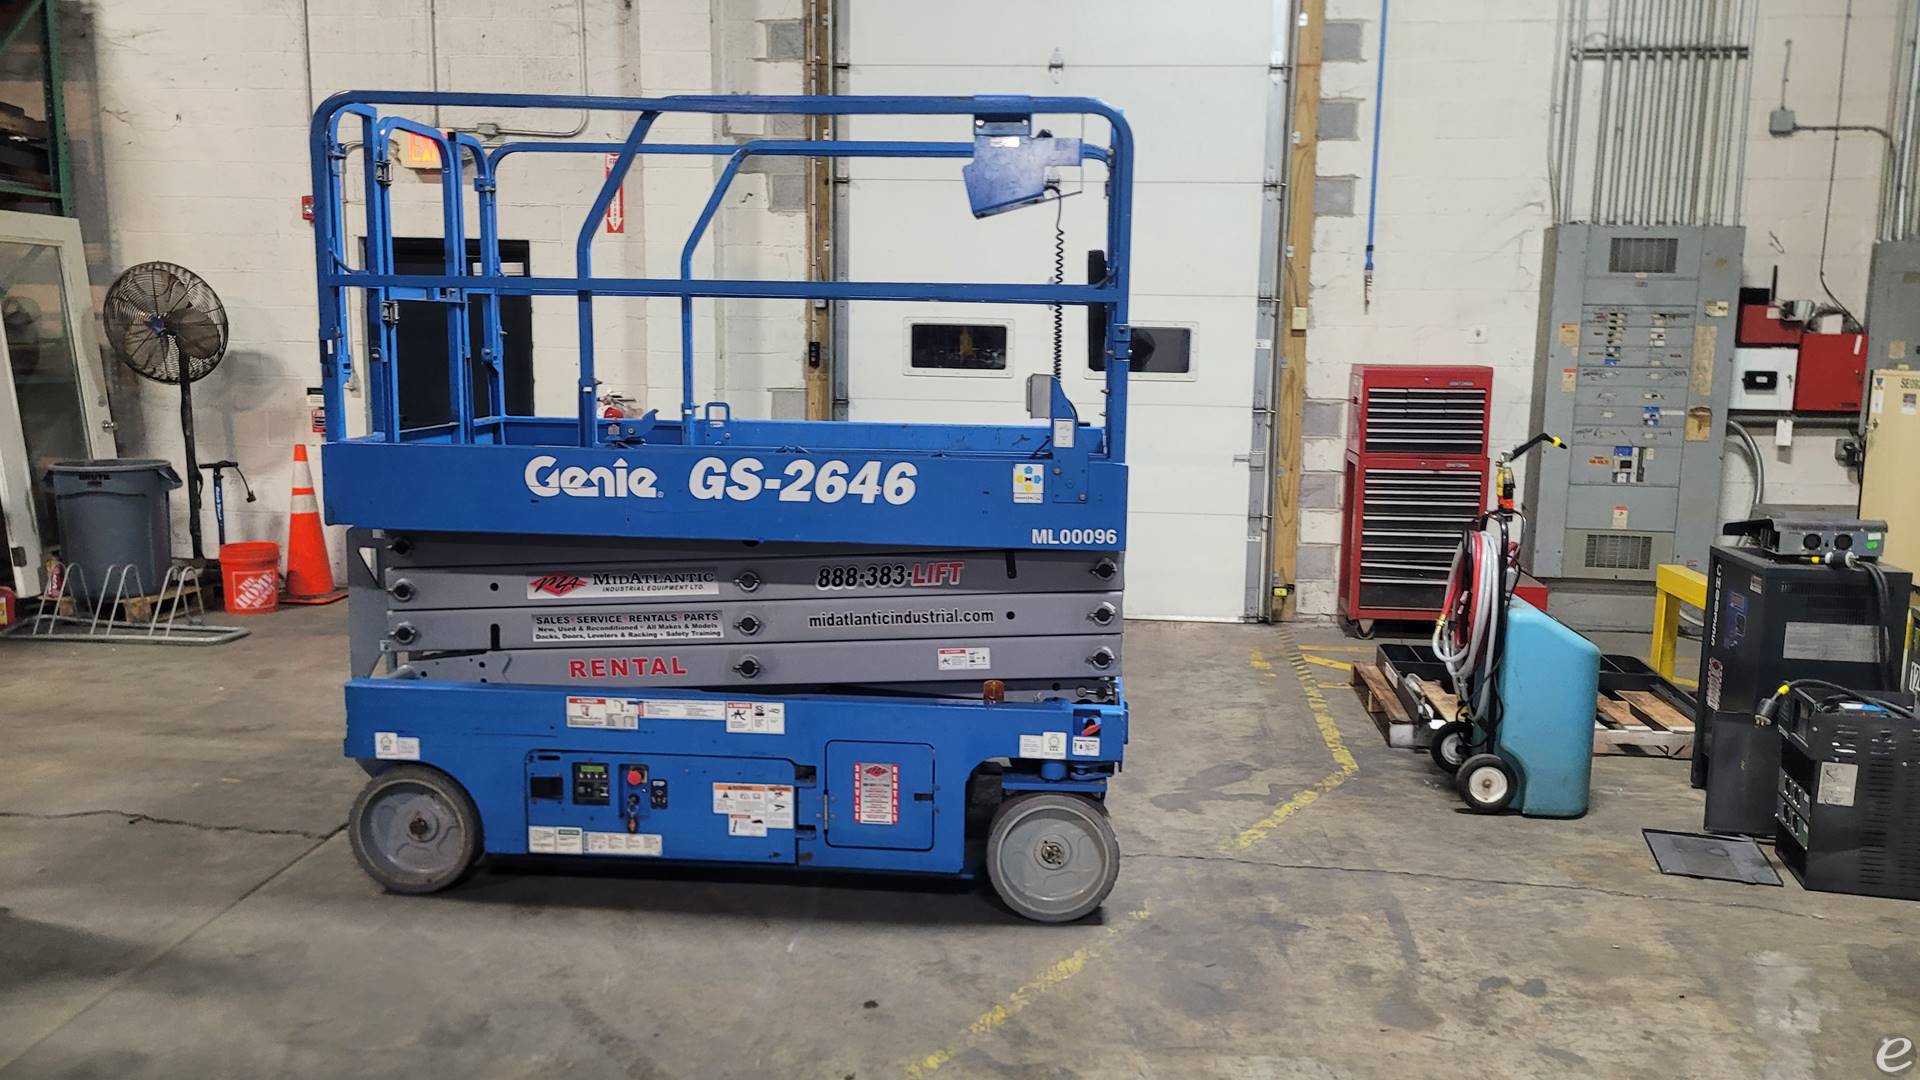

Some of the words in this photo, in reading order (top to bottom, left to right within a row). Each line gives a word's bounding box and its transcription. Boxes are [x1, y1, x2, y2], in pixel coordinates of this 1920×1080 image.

[524, 455, 659, 498] Genie
[688, 456, 918, 505] GS-2646
[1031, 528, 1118, 544] ML00096
[235, 573, 272, 609] HOME
[647, 584, 688, 592] EQUIPMENT
[536, 616, 570, 624] SALES
[576, 615, 622, 624] SERVICE
[629, 614, 678, 622] RENTALS
[684, 613, 719, 621] PARTS
[808, 609, 994, 627] midatlanticindustrial.com
[569, 656, 688, 679] RENTAL
